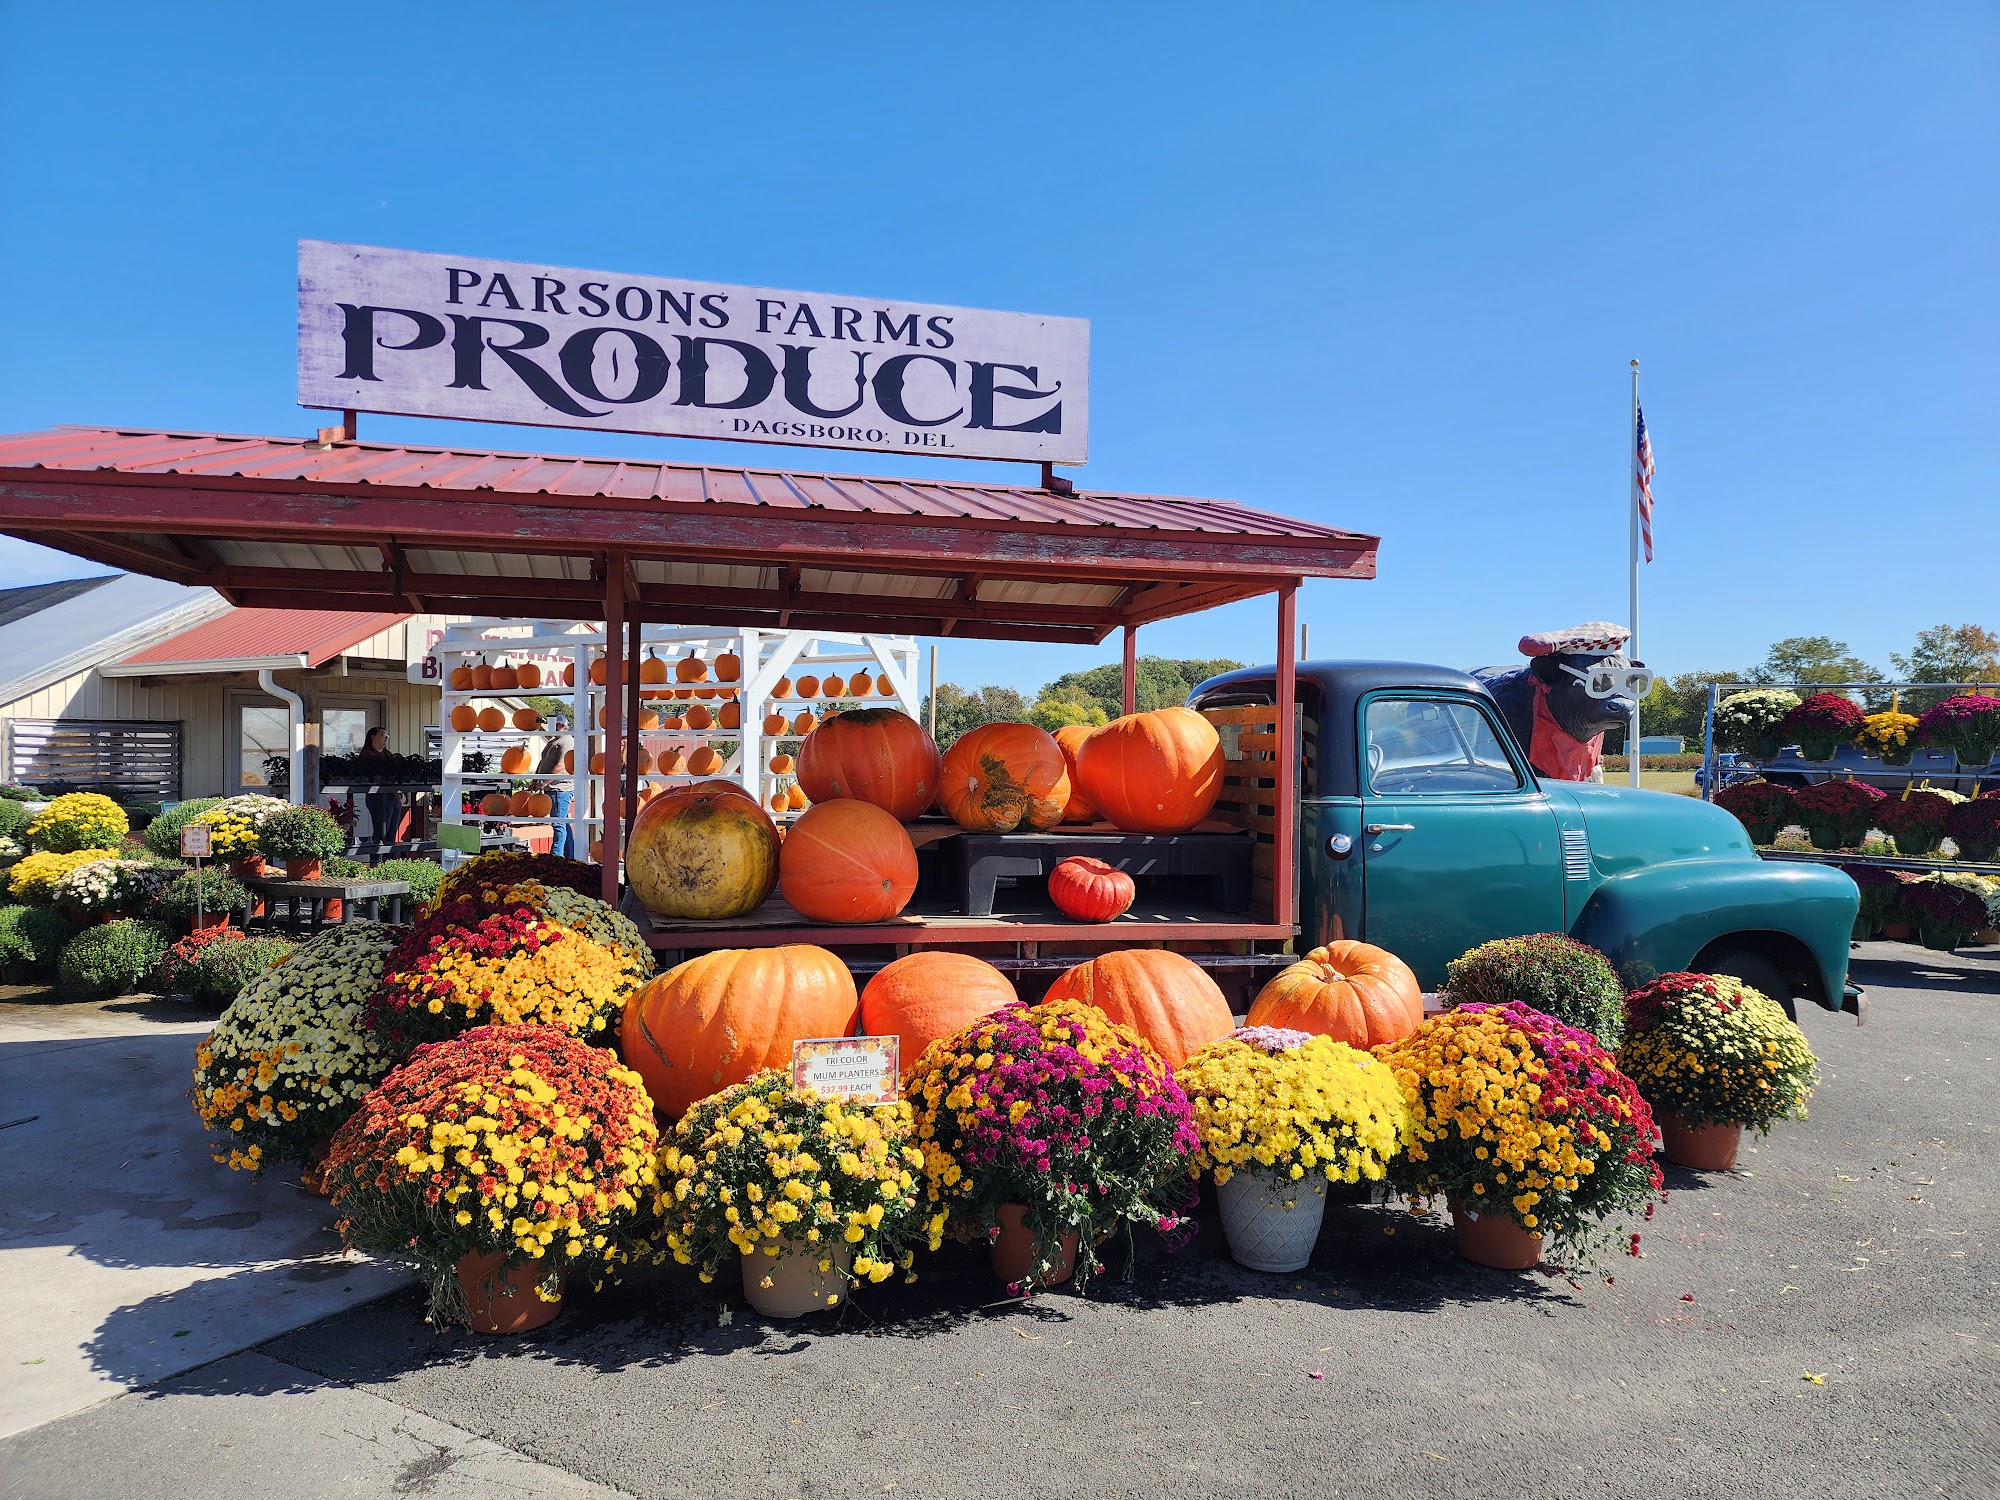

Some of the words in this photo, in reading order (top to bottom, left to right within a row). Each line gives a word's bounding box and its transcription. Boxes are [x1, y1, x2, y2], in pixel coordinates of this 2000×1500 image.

[446, 267, 730, 329] PARSONS
[755, 298, 956, 349] FARMS
[335, 302, 1062, 435] PRODUCE
[903, 431, 955, 448] DEL
[825, 1057, 838, 1065] TRI
[840, 1055, 868, 1064] COLOR
[813, 1071, 837, 1080] MUM
[839, 1068, 880, 1078] PLANTERS
[850, 1083, 872, 1091] EACH
